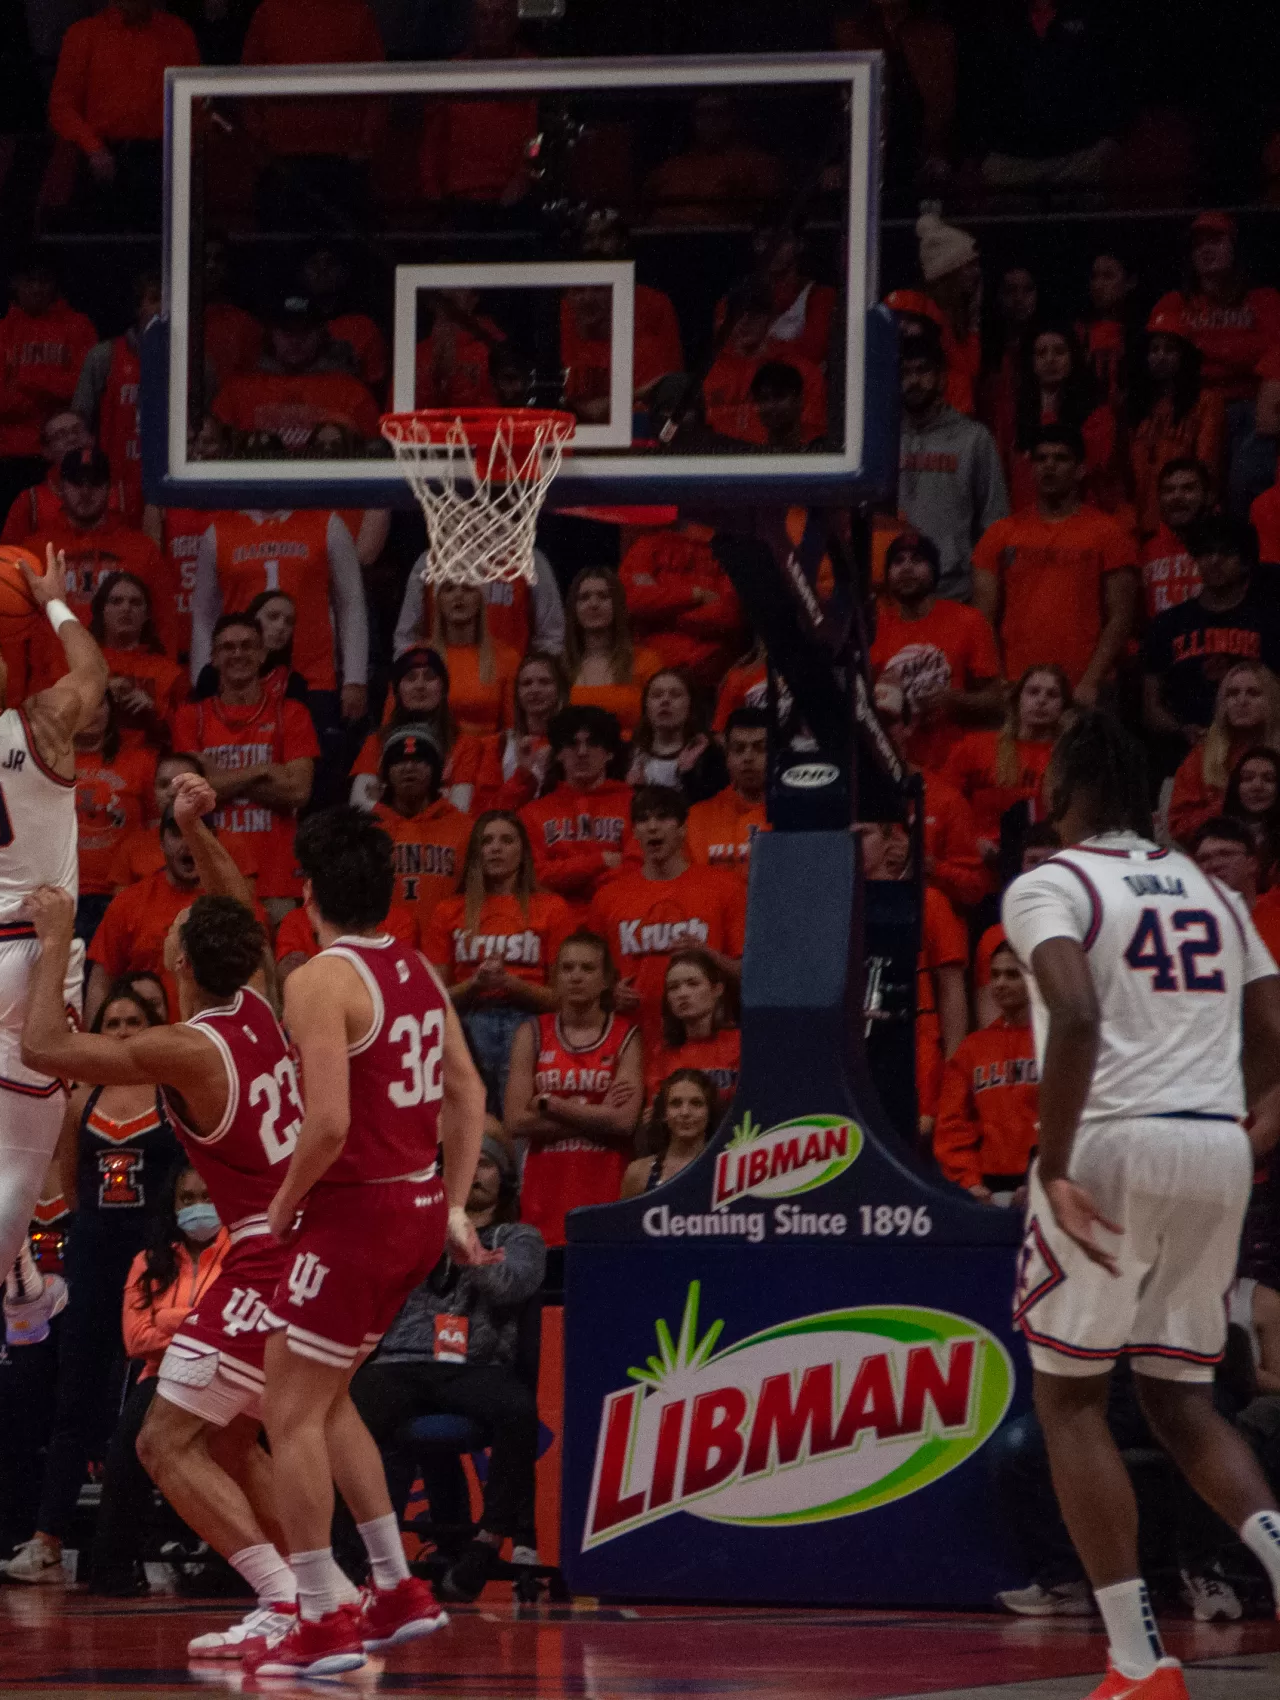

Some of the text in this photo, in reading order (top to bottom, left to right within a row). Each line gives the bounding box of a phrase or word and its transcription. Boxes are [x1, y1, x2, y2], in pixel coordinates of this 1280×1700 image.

[264, 560, 280, 591] 1
[1, 748, 27, 773] JR
[452, 927, 543, 966] Krush
[619, 917, 709, 957] Krush
[1124, 907, 1226, 992] 42
[388, 1007, 445, 1110] 32
[535, 1068, 611, 1092] ORANG
[249, 1055, 304, 1167] 23
[716, 1126, 849, 1202] LIBMAN
[642, 1203, 933, 1243] Cleaning Since 1896
[437, 1328, 466, 1345] AA
[588, 1338, 978, 1538] LIBMAN
